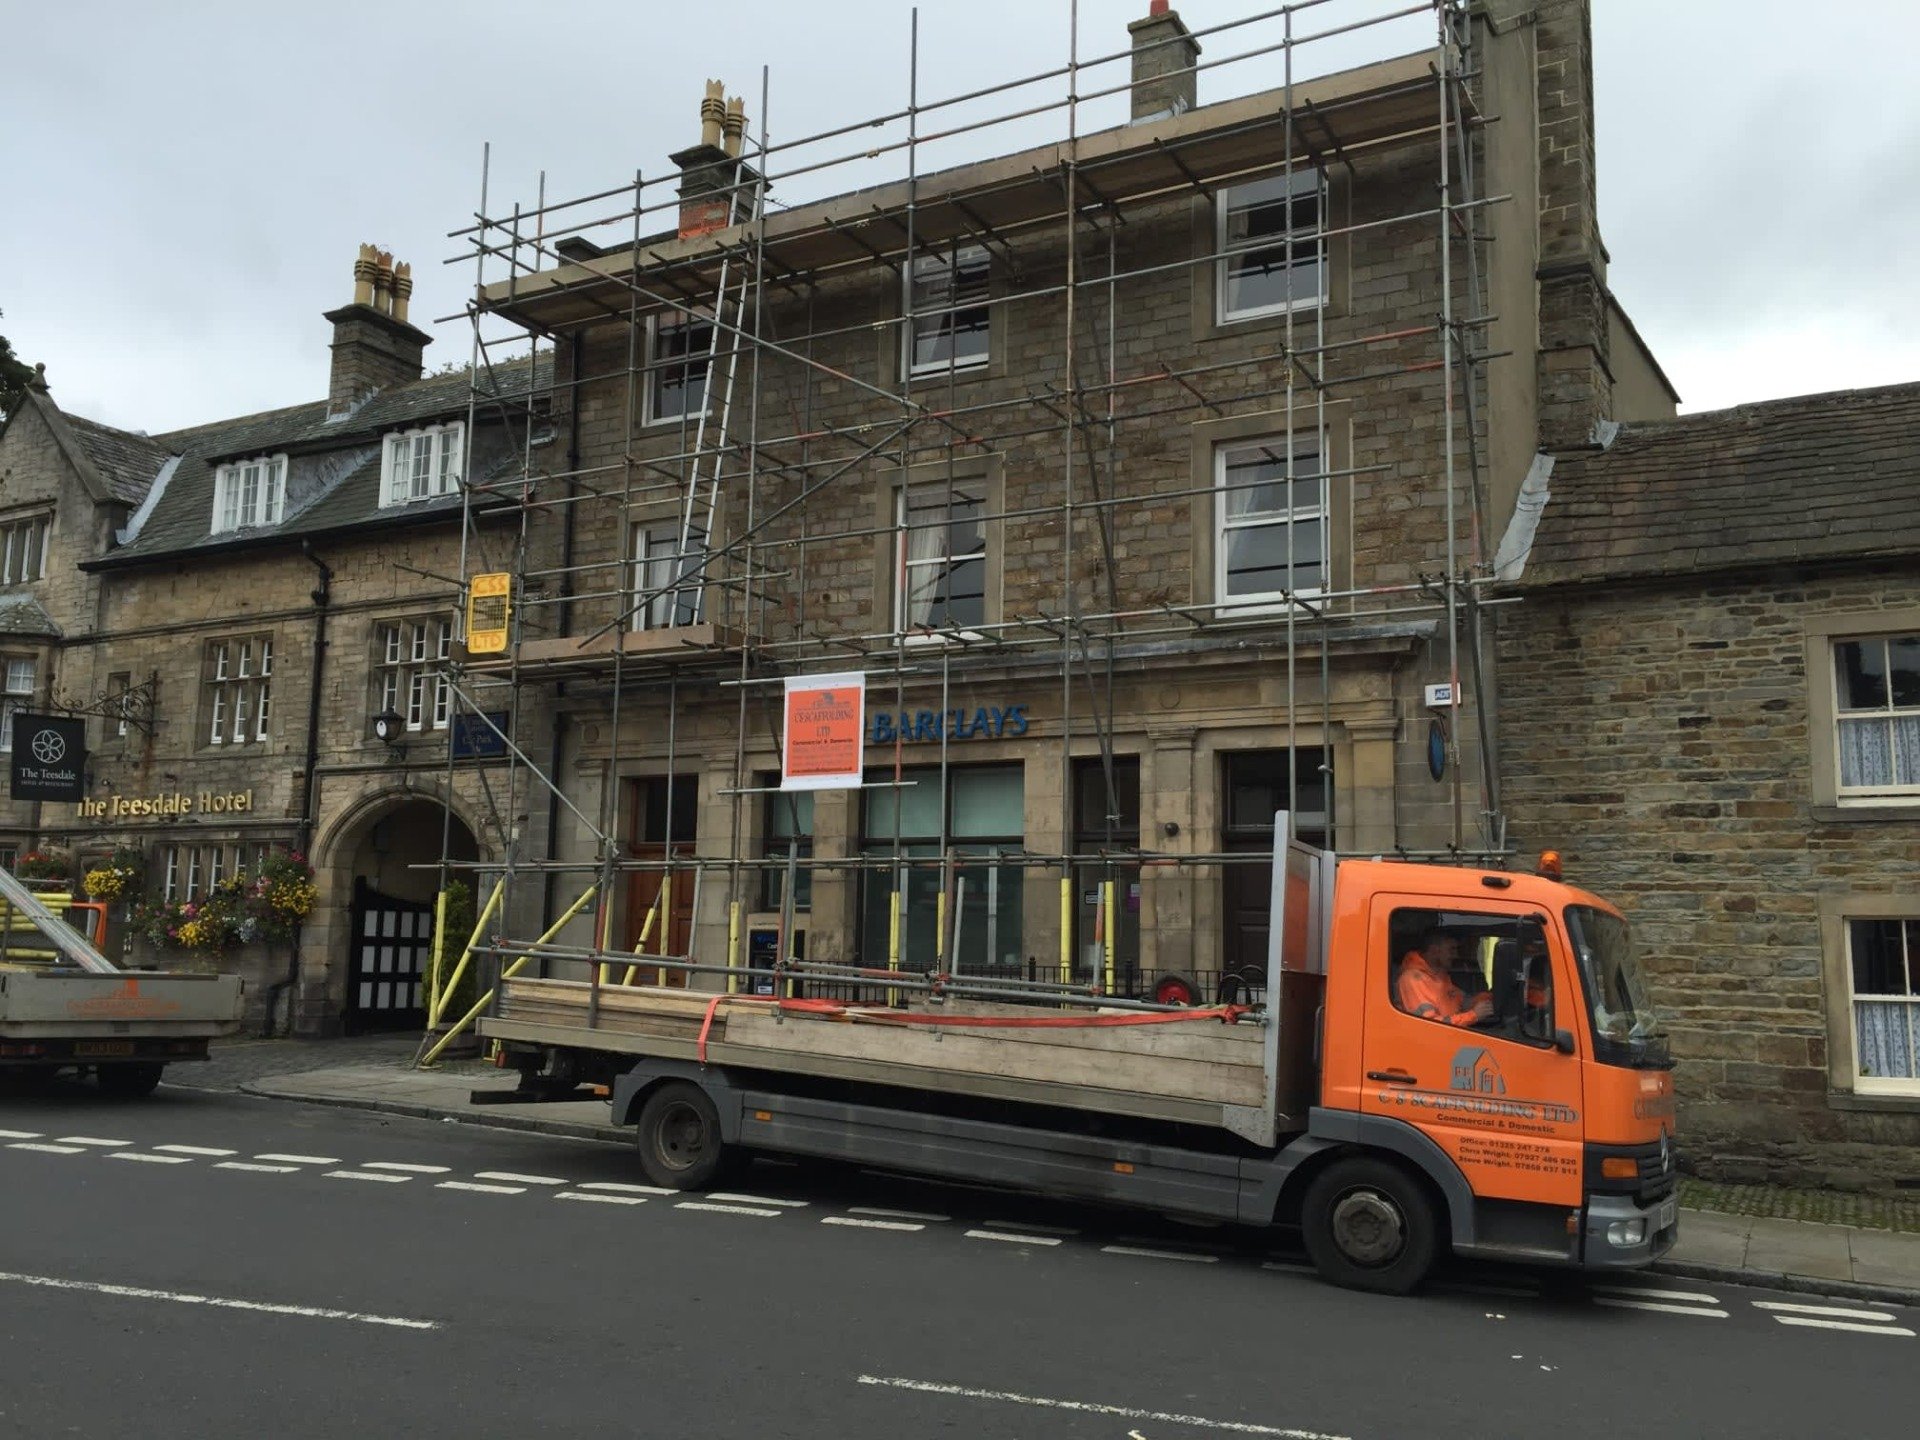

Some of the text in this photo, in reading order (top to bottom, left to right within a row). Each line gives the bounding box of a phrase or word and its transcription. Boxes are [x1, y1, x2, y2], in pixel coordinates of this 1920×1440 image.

[473, 632, 503, 649] LTD
[872, 704, 1028, 743] BARCLAYS
[20, 768, 76, 780] The Teesdale
[112, 792, 191, 816] Teesdale
[199, 789, 252, 813] Hotel
[1411, 1093, 1537, 1120] SCAFFOLDING
[1543, 1104, 1580, 1123] LTD
[1437, 1113, 1555, 1134] Commercial & Domestic
[1458, 1155, 1481, 1165] Steve
[1459, 1146, 1480, 1156] Chris
